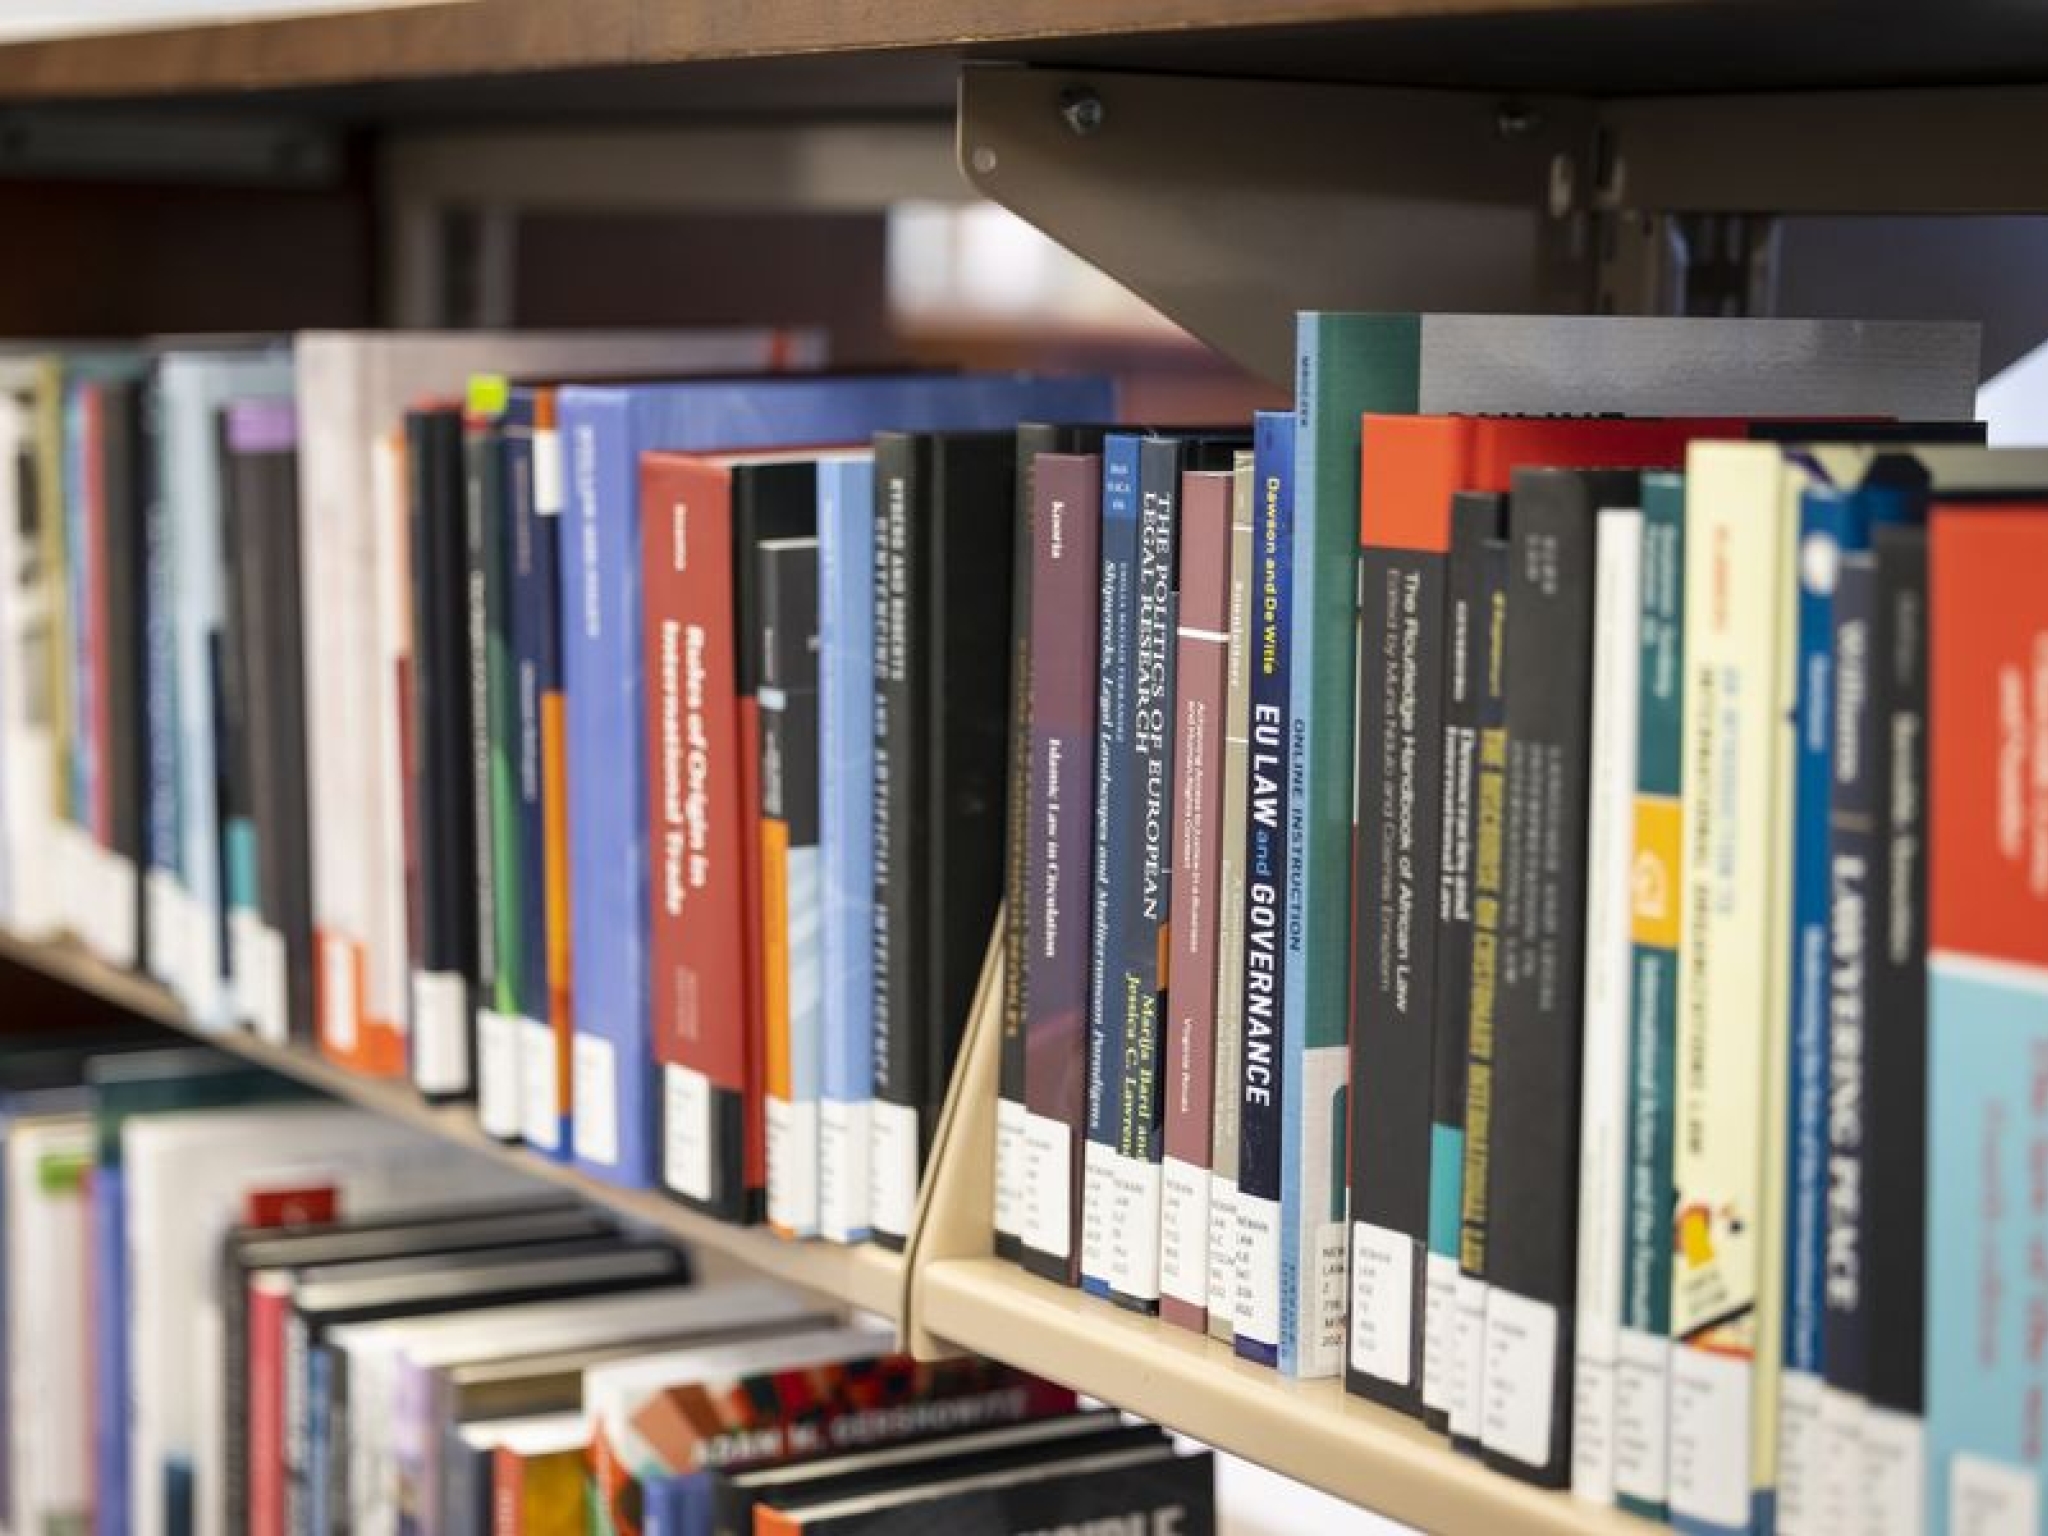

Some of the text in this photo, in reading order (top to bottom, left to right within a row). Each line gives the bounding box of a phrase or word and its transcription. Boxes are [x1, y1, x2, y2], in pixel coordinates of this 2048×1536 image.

[891, 555, 906, 593] AND
[891, 598, 906, 681] ROBERTS
[1135, 491, 1157, 754] LEGAL RESEARCH
[1262, 478, 1280, 674] Dawson and De Witte
[1383, 632, 1398, 656] by
[1386, 568, 1401, 629] Edited
[662, 620, 687, 917] International Trade
[685, 625, 710, 887] Rules of Origin in
[1143, 491, 1171, 920] THE POLITICS OF EUROPEAN
[1383, 780, 1396, 818] and
[1396, 572, 1421, 1014] The Routledge Handbook of African Law
[874, 749, 889, 884] ARTIFICIAL
[1045, 738, 1063, 957] Islamic Law in Circulation
[1089, 560, 1117, 1128] Shipwrecks, Legal Landscapes and Mediterranean Paradigms
[1245, 704, 1280, 1107] EU LAW and GOVERNANCE
[1289, 719, 1306, 951] ONLINE INSTRUCTION
[1454, 876, 1472, 920] and
[874, 904, 889, 1087] INTELLIGENCE
[1125, 972, 1140, 1039] Jessica
[1125, 1048, 1137, 1068] C.
[1826, 855, 1867, 1311] LAWYERING PEACE
